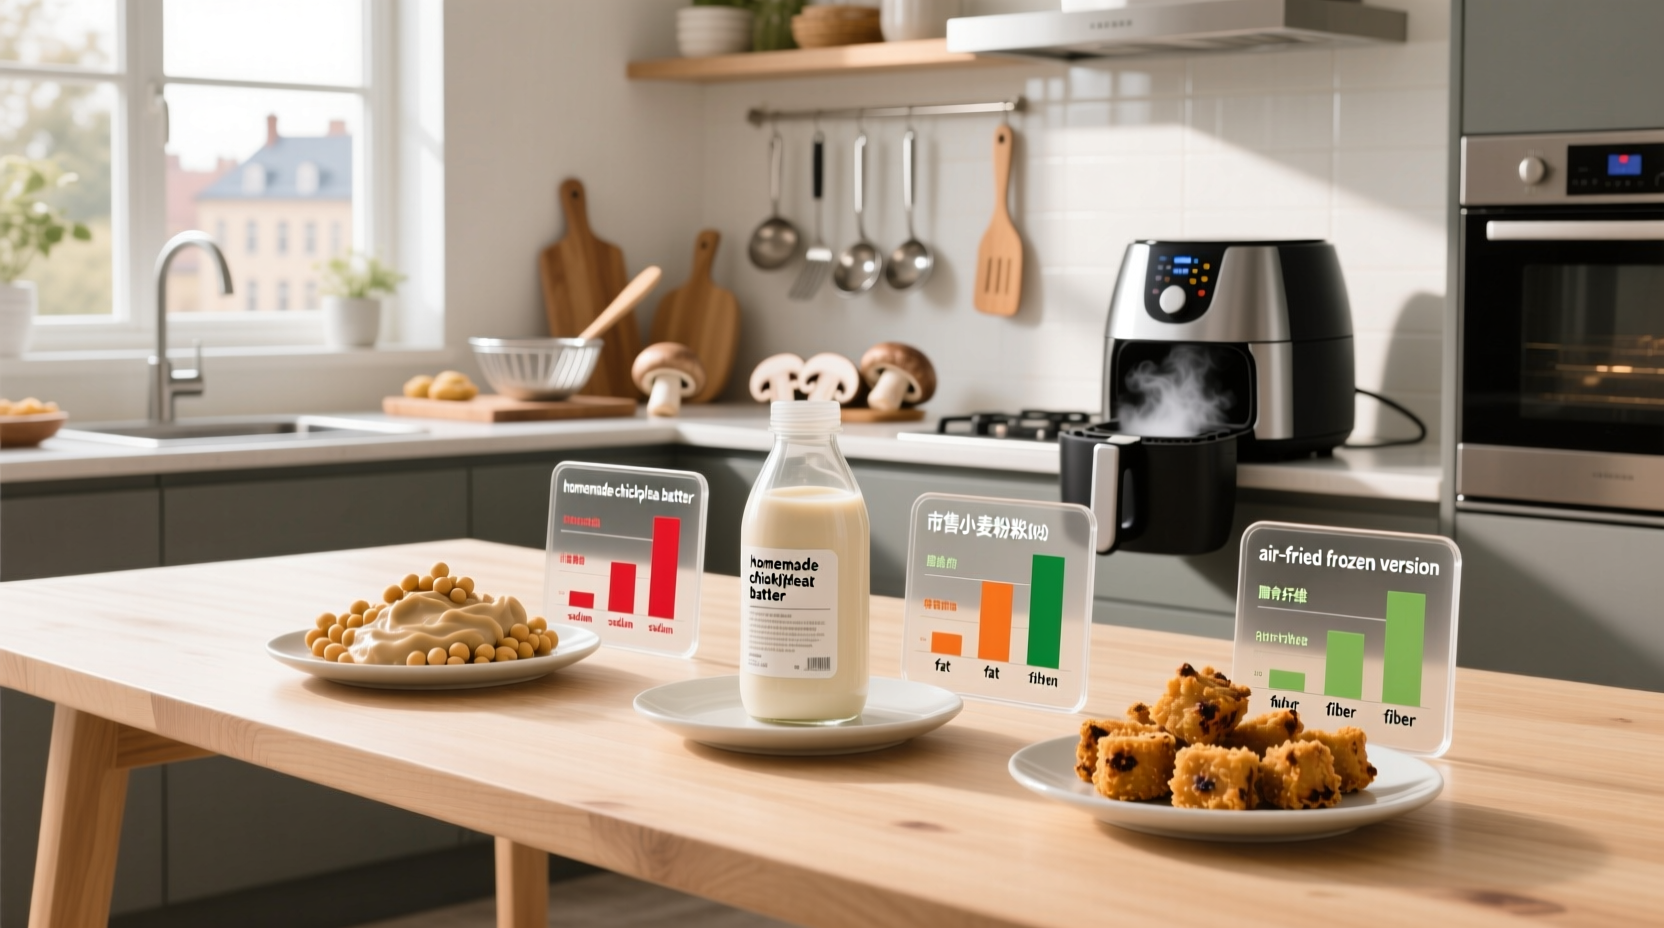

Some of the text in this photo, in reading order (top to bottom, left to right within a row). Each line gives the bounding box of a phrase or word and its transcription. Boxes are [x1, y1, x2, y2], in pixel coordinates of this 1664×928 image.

[750, 554, 819, 571] homemade
[1259, 545, 1440, 576] air-fried frozen version
[935, 658, 951, 673] fat
[983, 665, 1000, 680] fat
[1326, 702, 1357, 718] fiber
[1384, 709, 1417, 727] fiber
